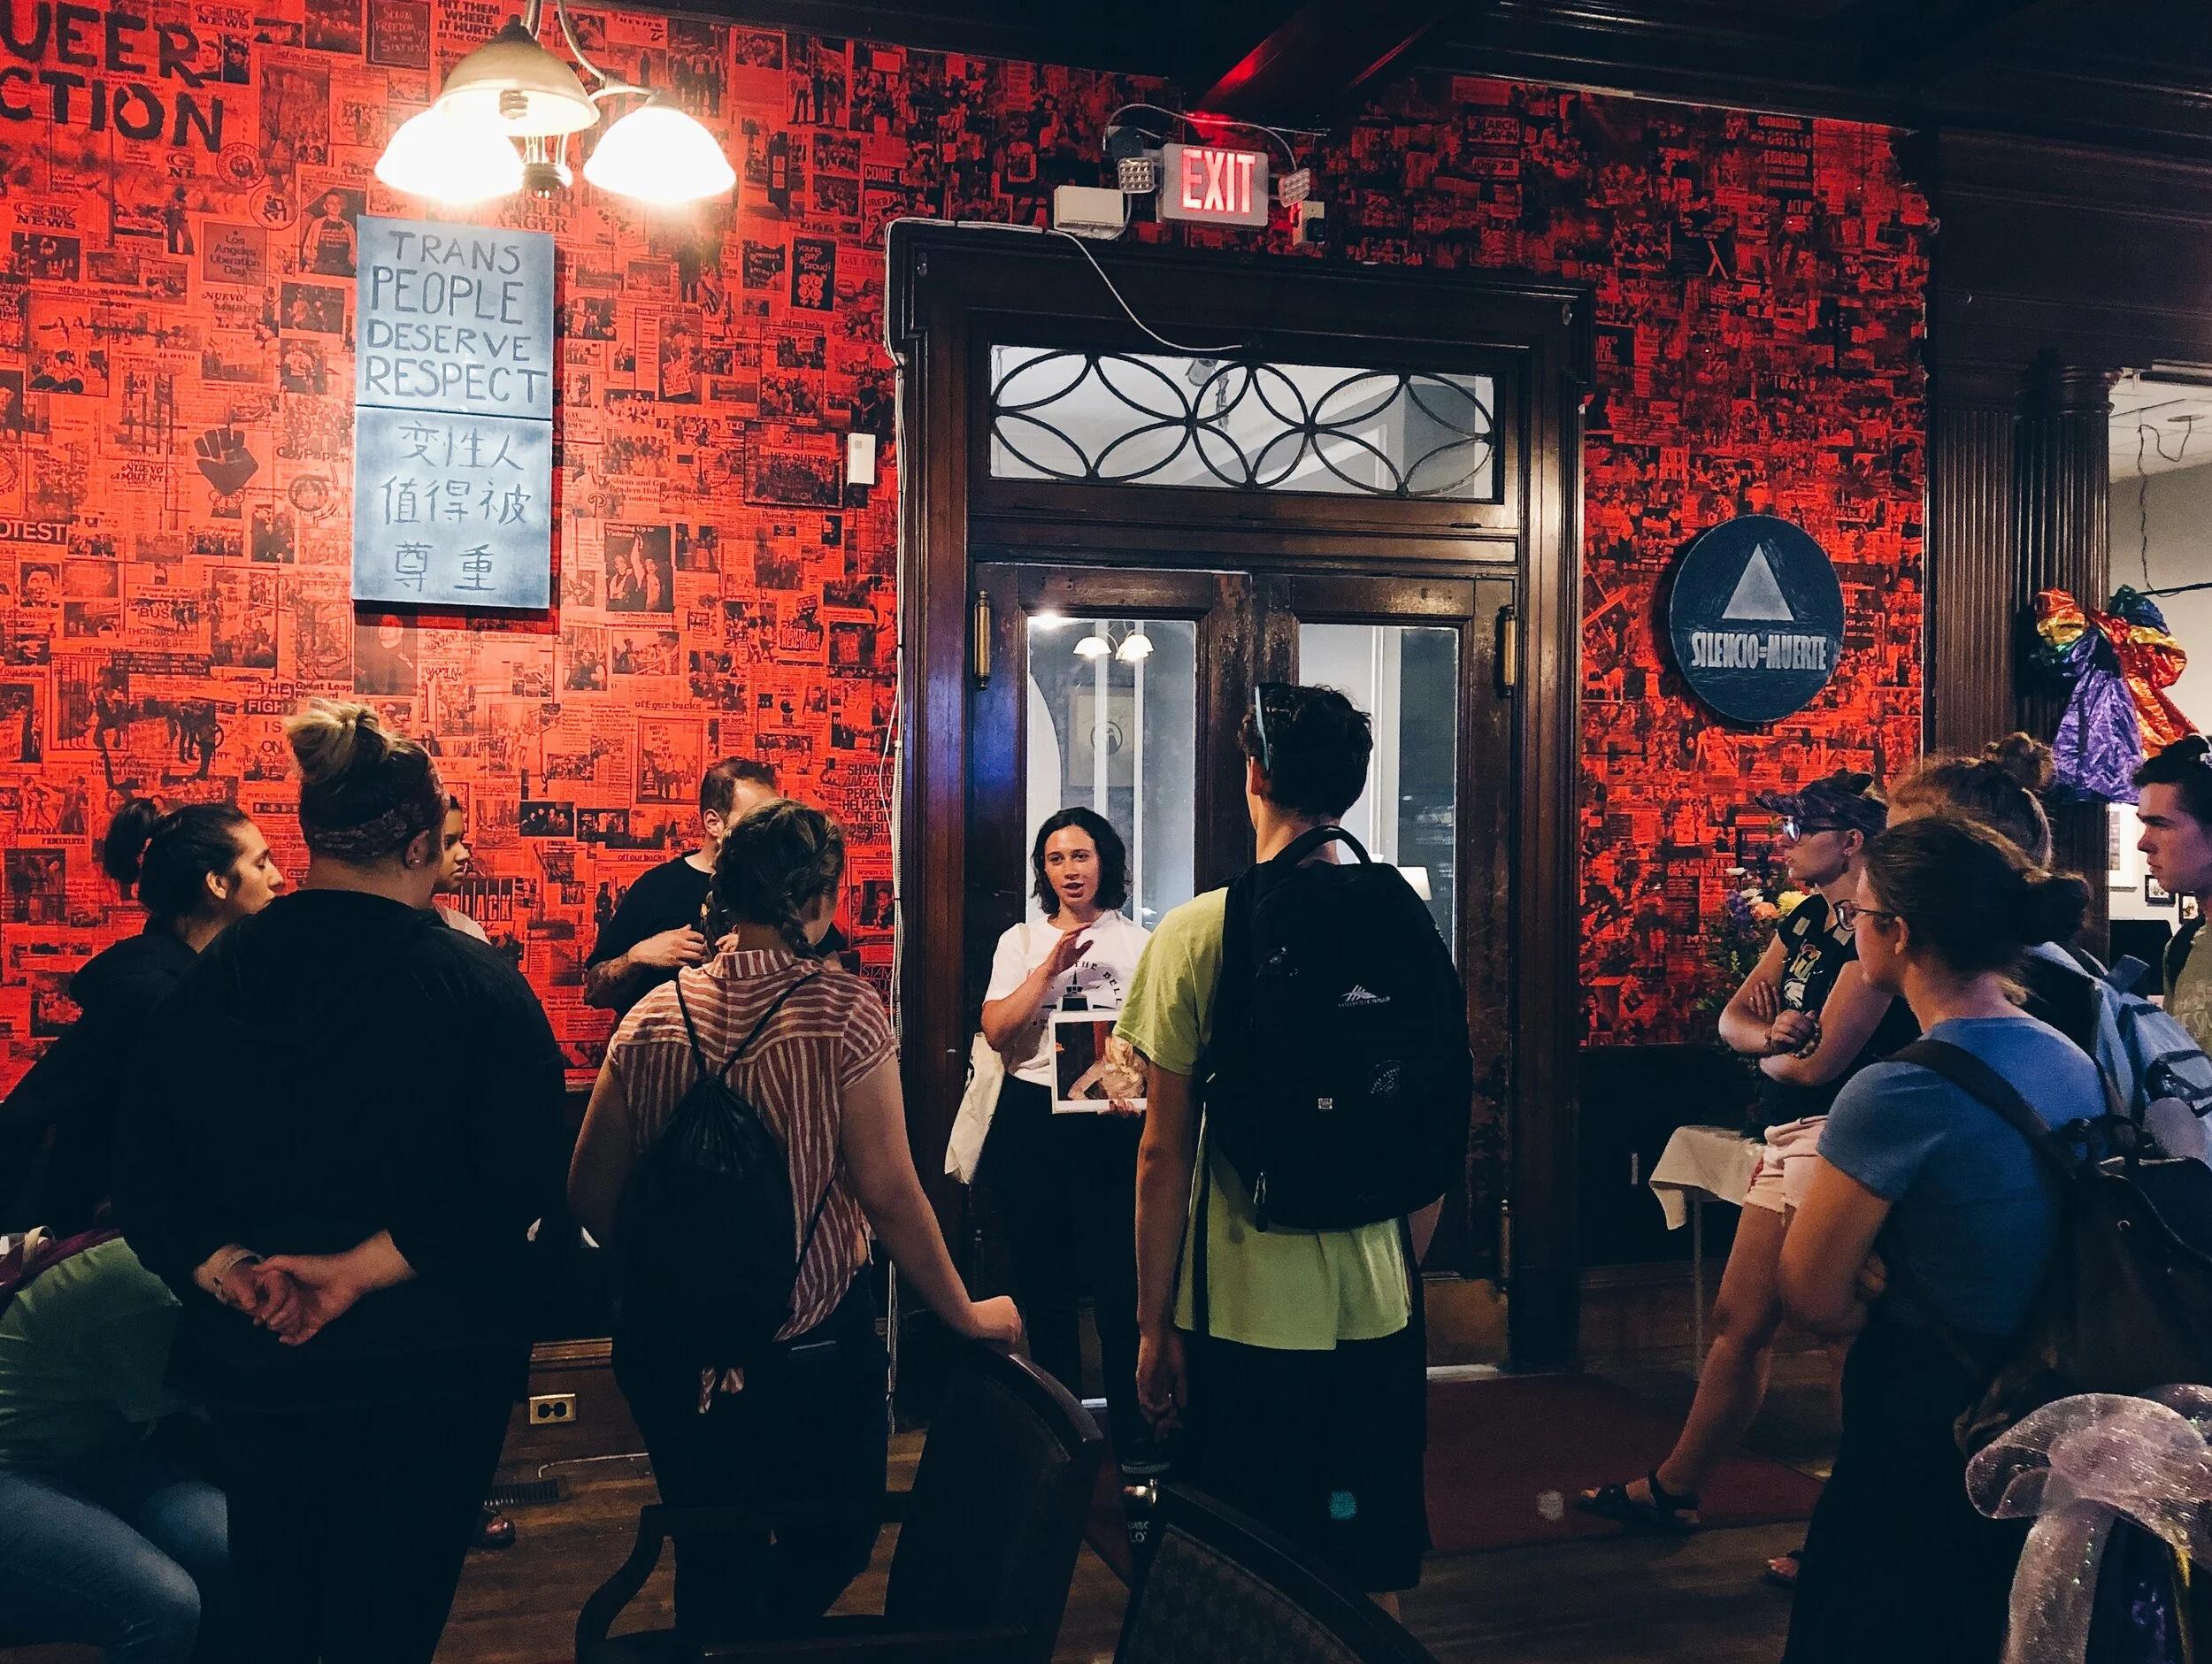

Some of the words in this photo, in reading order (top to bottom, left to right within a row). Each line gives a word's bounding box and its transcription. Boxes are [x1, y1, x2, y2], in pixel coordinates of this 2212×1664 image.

[445, 11, 493, 24] WHERE
[439, 19, 450, 31] IT
[453, 21, 497, 36] HURTS
[0, 65, 223, 154] CTION
[864, 165, 895, 183] COME
[1182, 148, 1256, 213] EXIT
[16, 214, 77, 230] NEWS
[495, 212, 568, 234] ANGER
[226, 234, 246, 245] Los
[210, 254, 260, 267] Liberation
[389, 230, 520, 274] TRANS
[372, 265, 524, 325] PEOPLE
[367, 318, 532, 361] DESERVE
[365, 355, 548, 403] RESPECT
[399, 420, 524, 471] 变性人
[380, 475, 532, 525] 值得被
[395, 541, 496, 593] 尊重
[328, 682, 352, 693] Leap
[672, 701, 701, 709] backs
[265, 720, 282, 733] IS
[261, 740, 283, 752] ON
[847, 763, 880, 776] SHOW
[1073, 960, 1098, 971] THE
